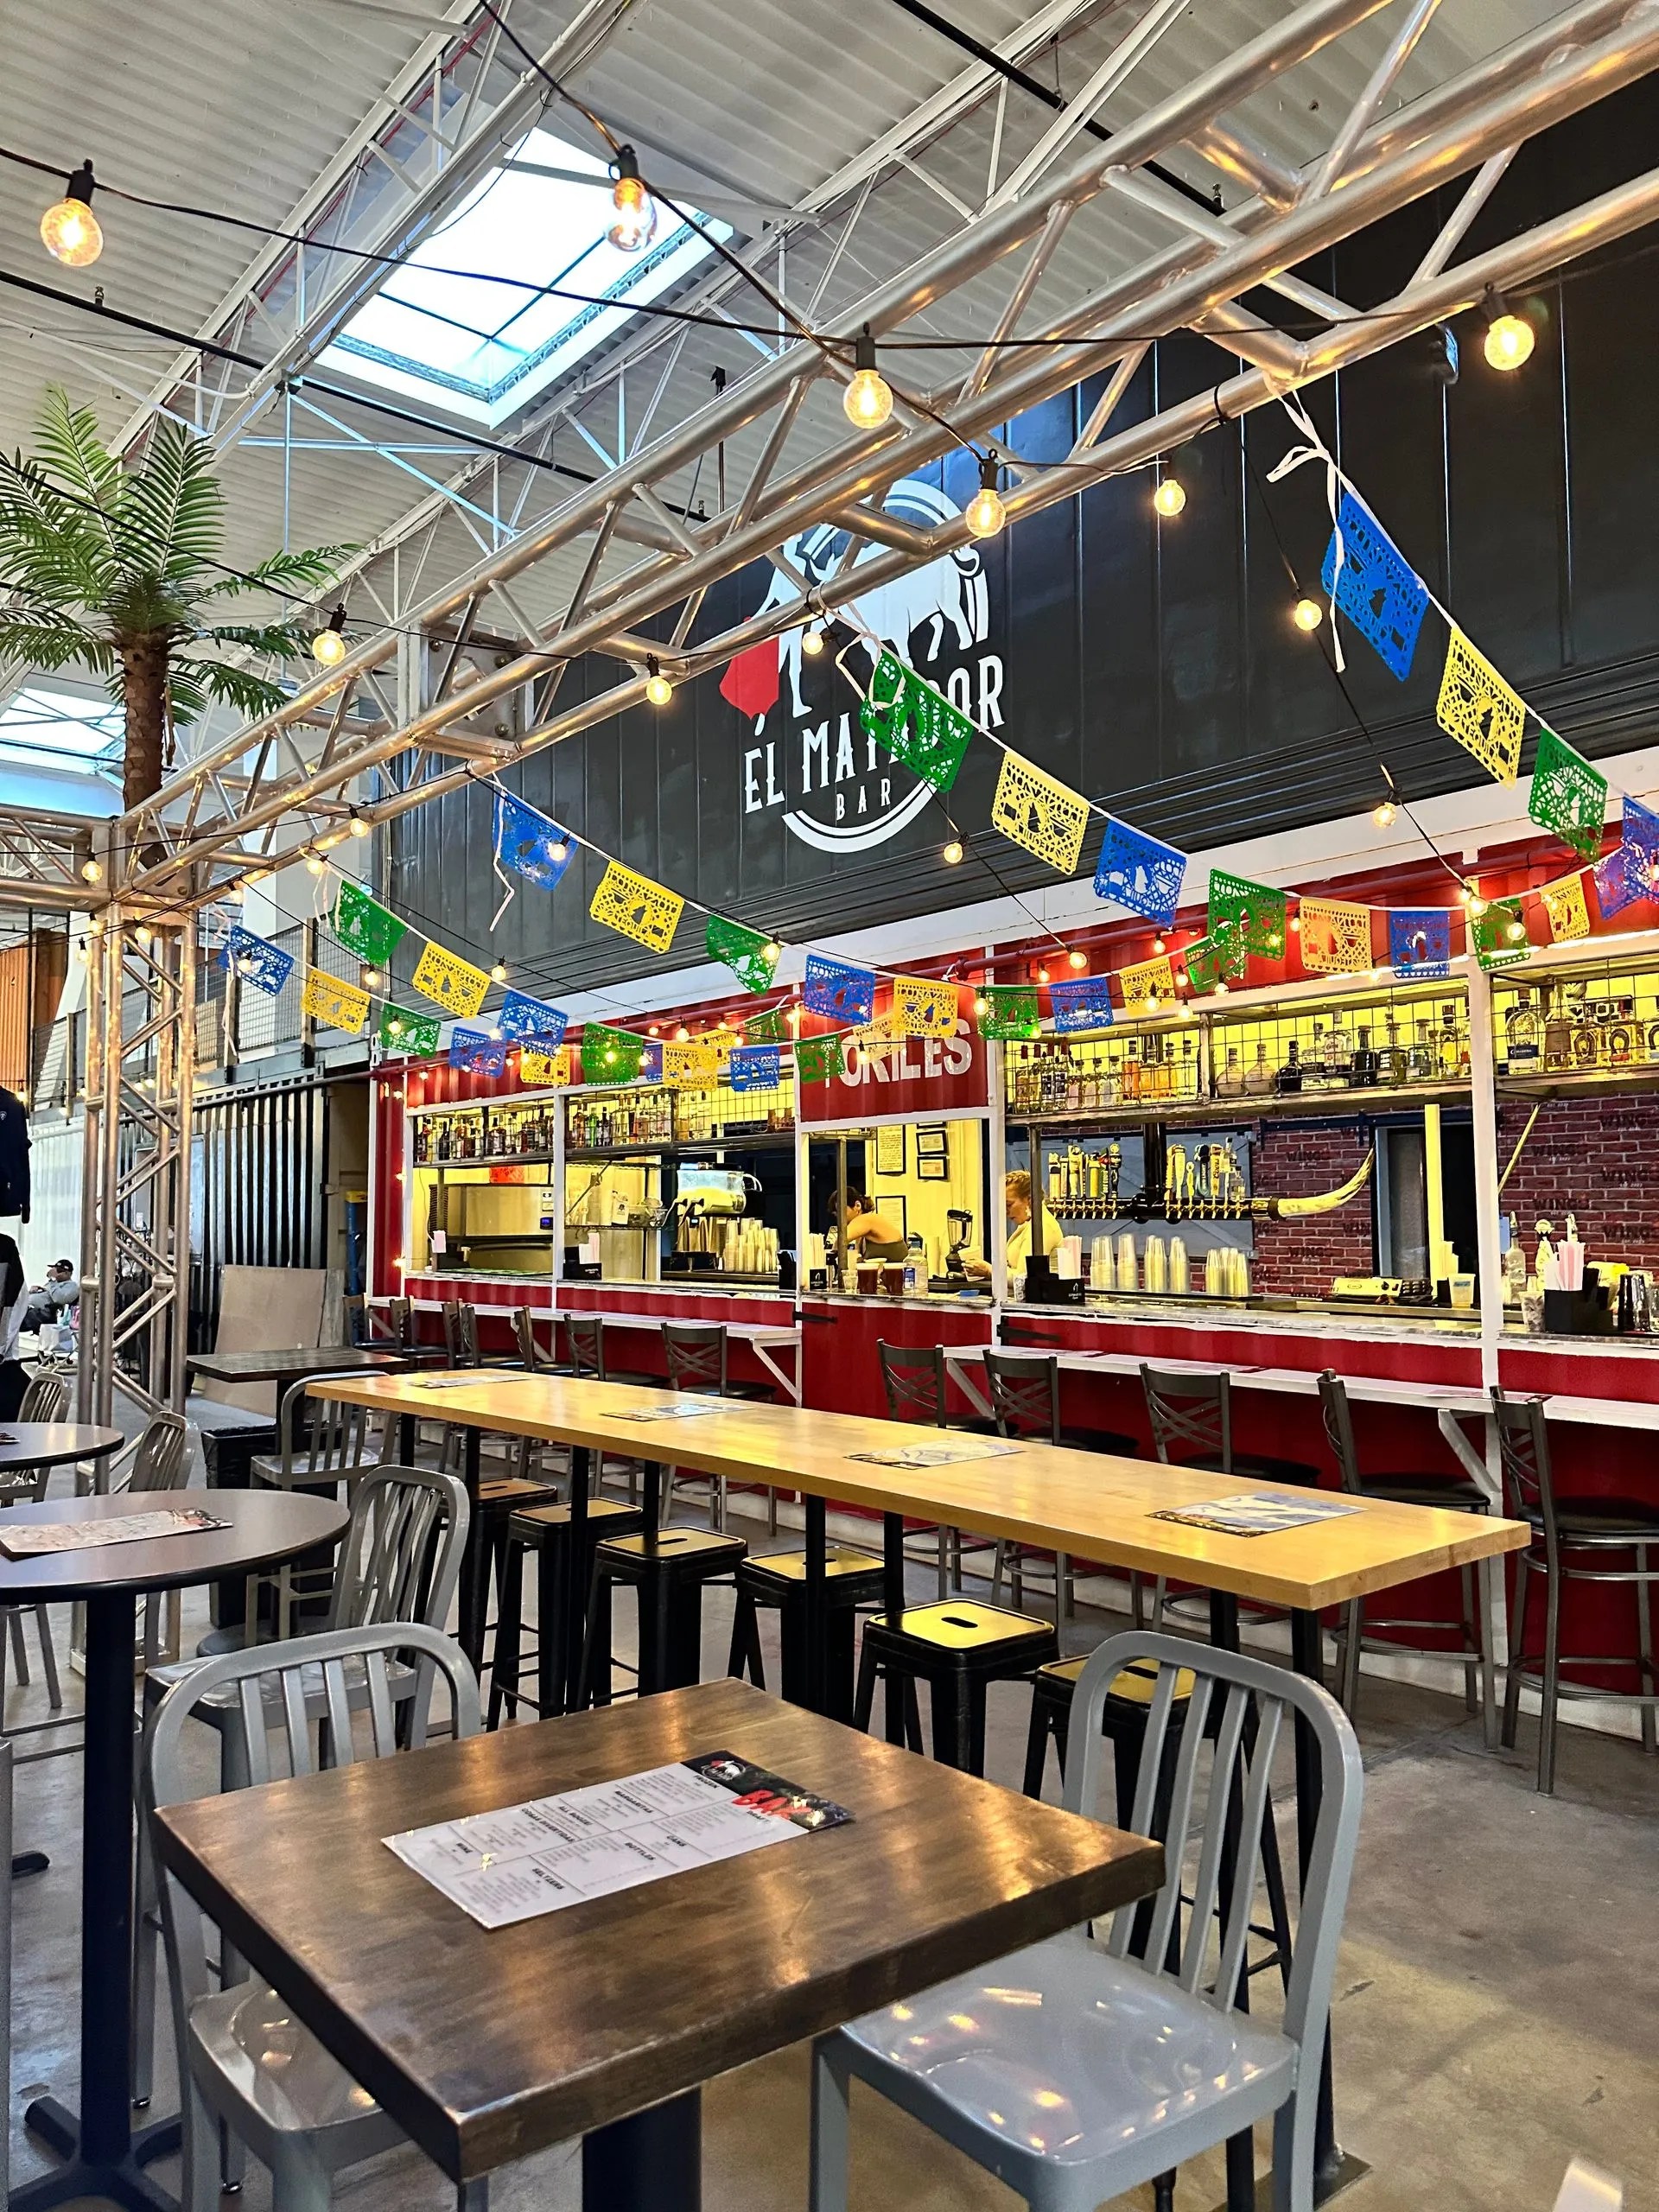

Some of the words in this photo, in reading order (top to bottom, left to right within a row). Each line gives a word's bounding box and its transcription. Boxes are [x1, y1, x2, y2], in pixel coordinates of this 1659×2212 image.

[801, 655, 1006, 794] MATOR
[836, 778, 891, 821] BAR
[732, 1789, 813, 1821] BAR
